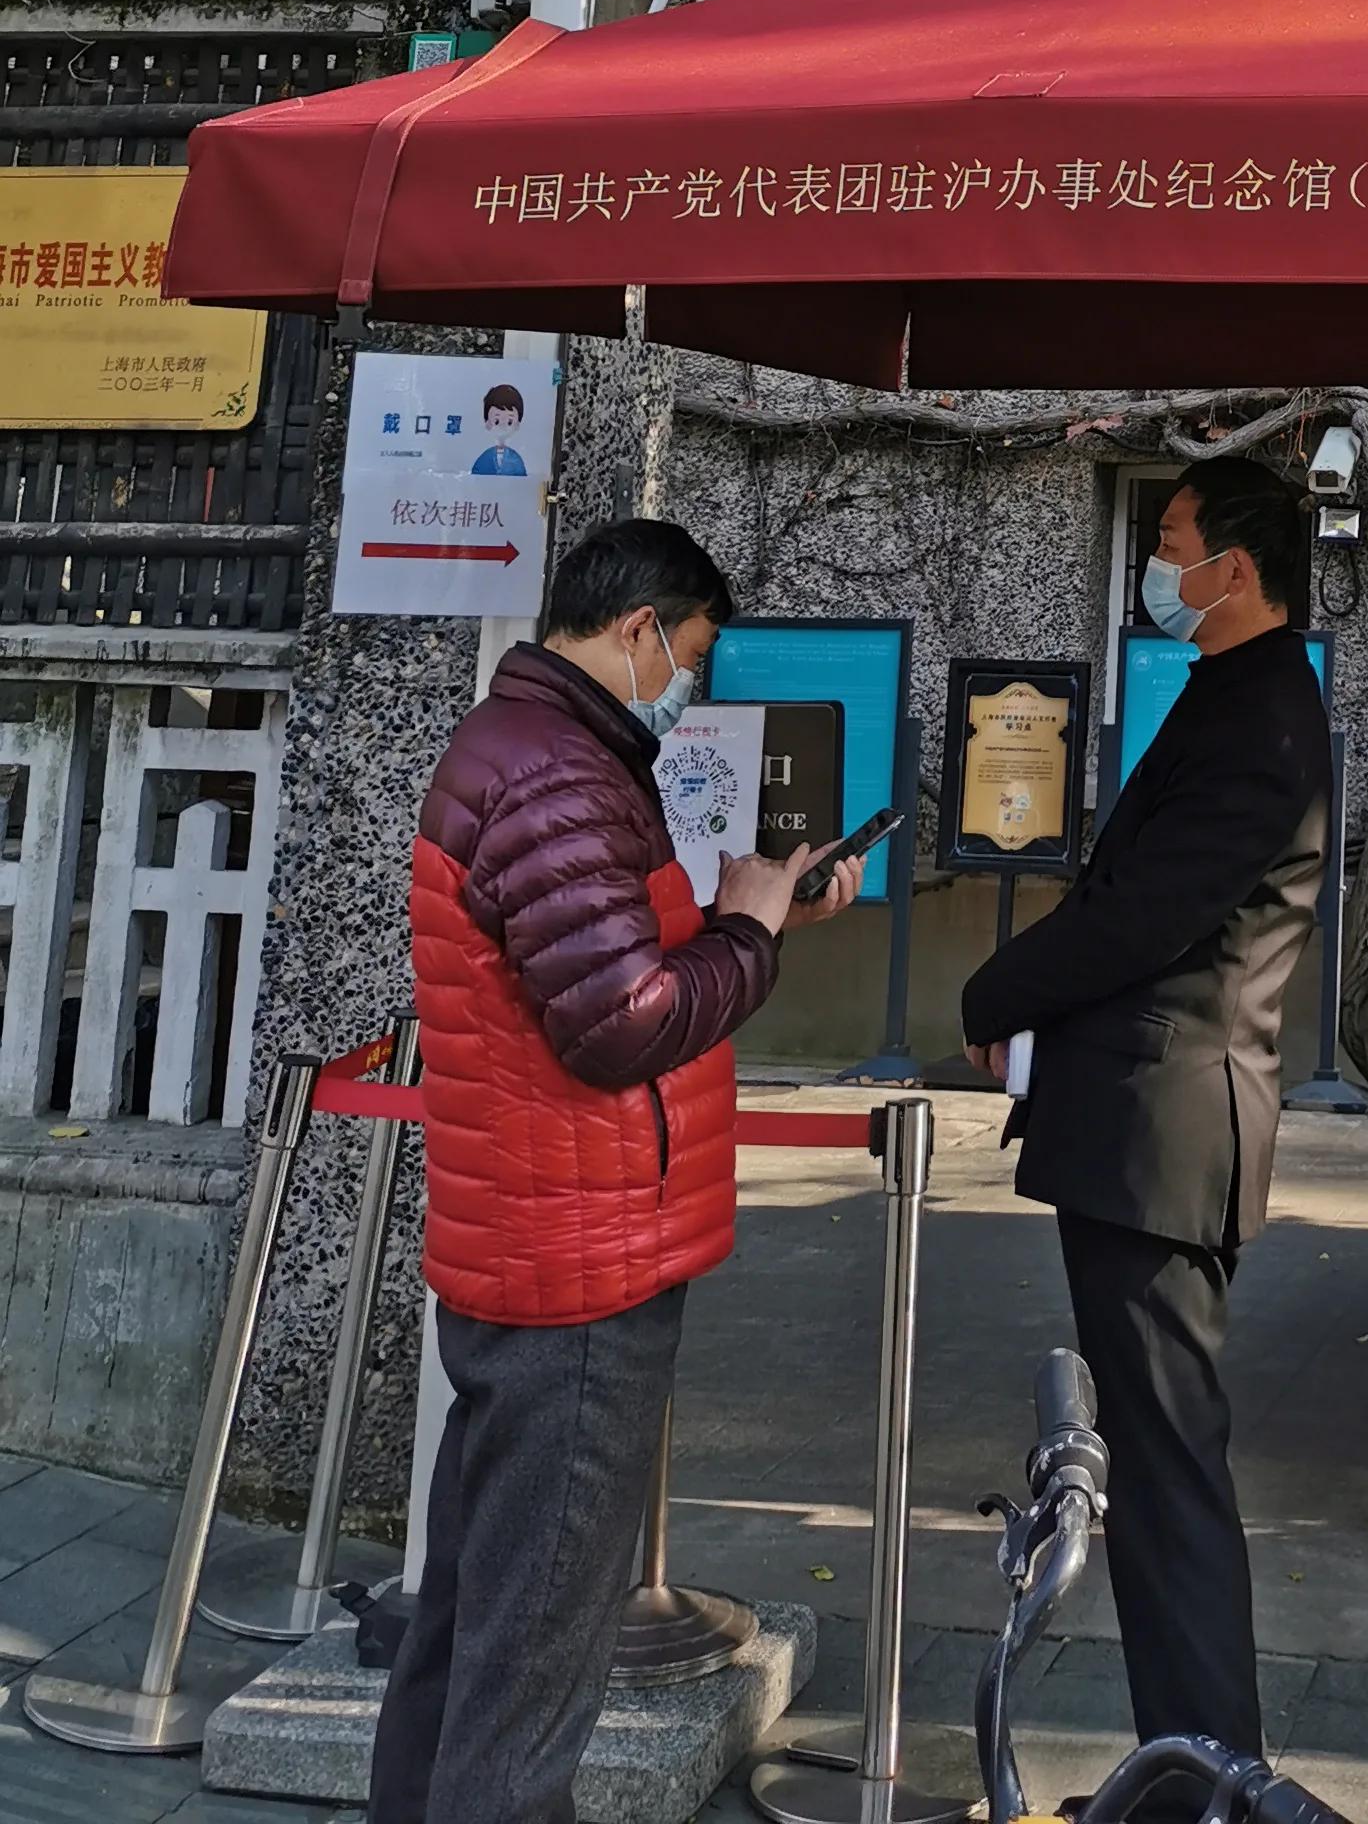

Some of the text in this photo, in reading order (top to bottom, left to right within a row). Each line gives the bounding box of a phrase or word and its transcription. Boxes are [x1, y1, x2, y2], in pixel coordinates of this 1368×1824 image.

[36, 293, 103, 307] Patriotic
[100, 356, 207, 373] 上海市人民政府
[382, 412, 463, 436] 戴口罩
[390, 498, 504, 528] 依次排队
